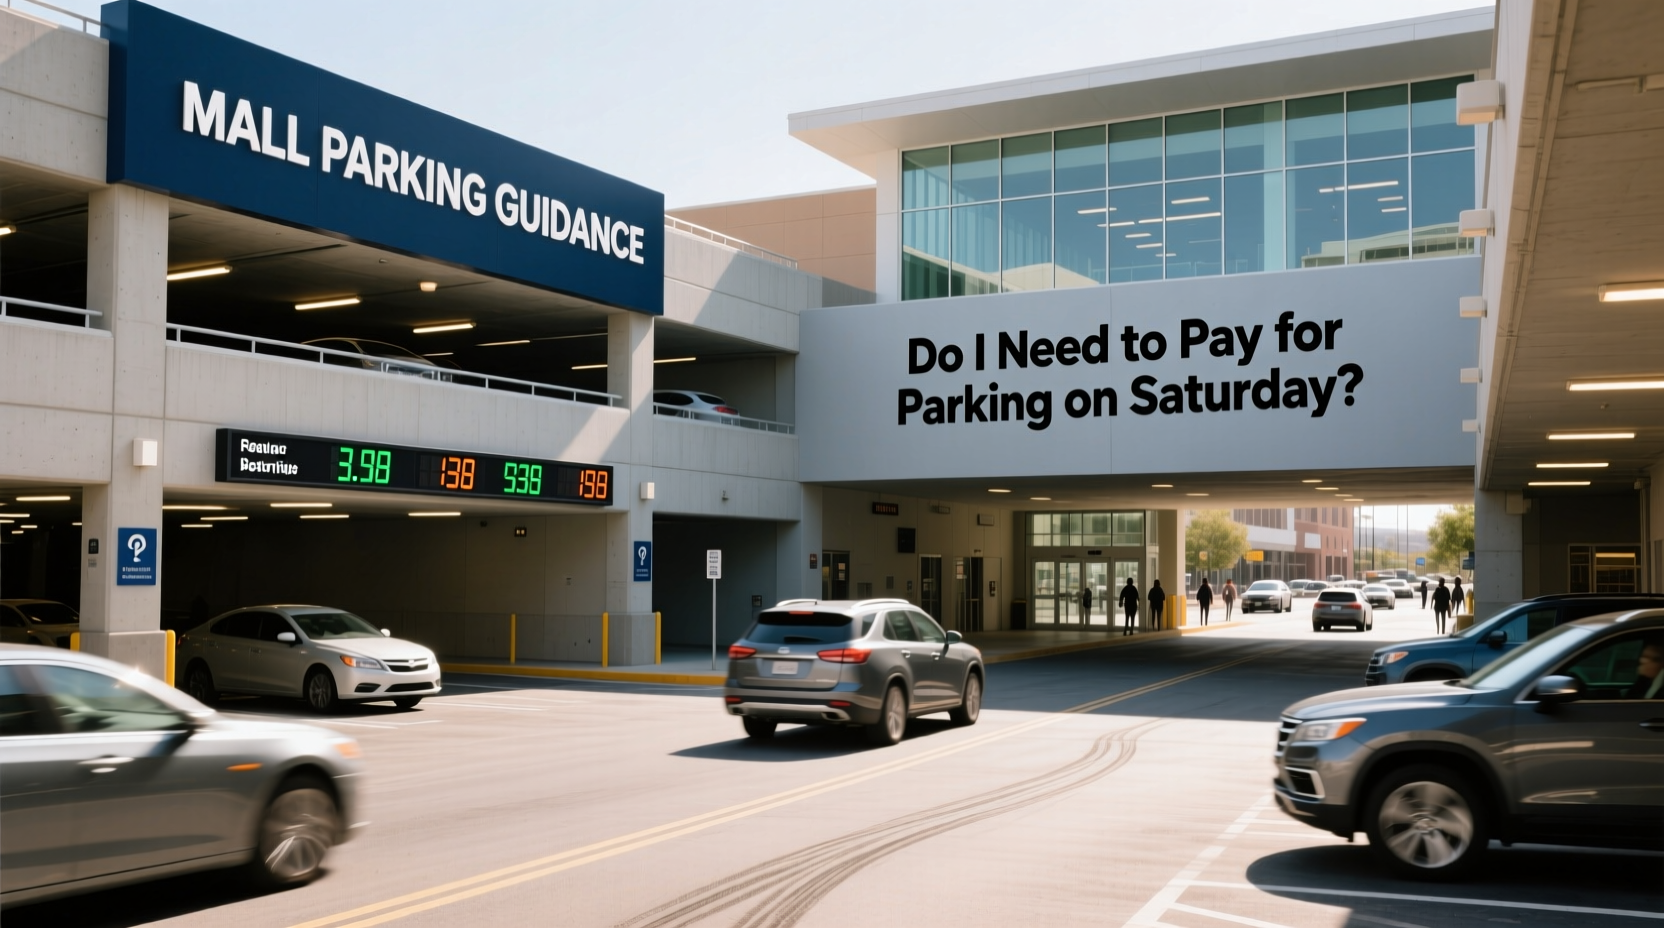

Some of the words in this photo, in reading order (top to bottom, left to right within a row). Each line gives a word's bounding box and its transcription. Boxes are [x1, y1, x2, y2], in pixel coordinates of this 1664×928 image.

[182, 80, 310, 167] MALL
[321, 125, 487, 217] PARKING
[494, 182, 645, 265] GUIDANCE
[908, 337, 964, 375] Do
[975, 333, 985, 371] I
[998, 323, 1109, 370] Need
[1120, 325, 1168, 362] to
[1180, 318, 1264, 367] Pay
[1274, 310, 1343, 353] for
[897, 381, 1053, 431] Parking
[1064, 387, 1118, 419] on
[1129, 362, 1364, 418] Saturday?
[440, 456, 476, 490] 138
